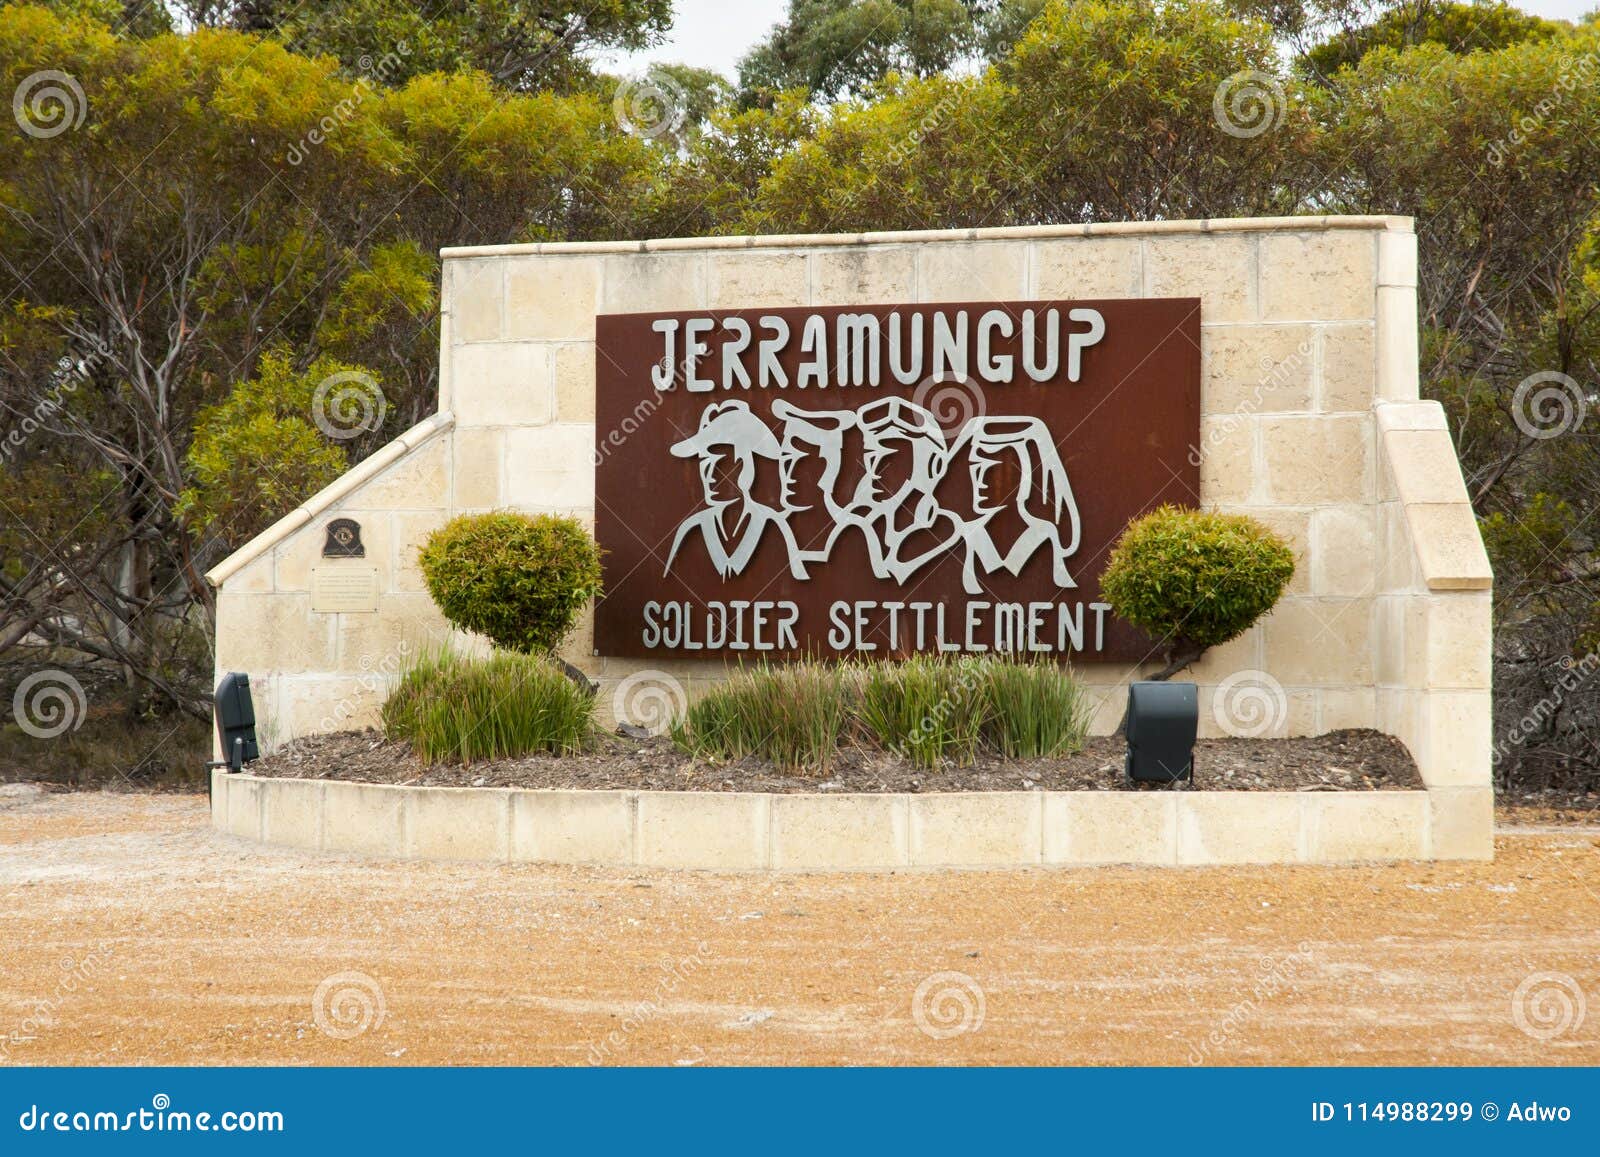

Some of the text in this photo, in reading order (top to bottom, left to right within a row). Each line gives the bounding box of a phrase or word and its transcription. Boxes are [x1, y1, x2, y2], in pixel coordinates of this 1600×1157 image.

[651, 308, 1106, 393] JERRAMUNGUP
[642, 600, 1112, 652] SOLDIER SETTLEMENT
